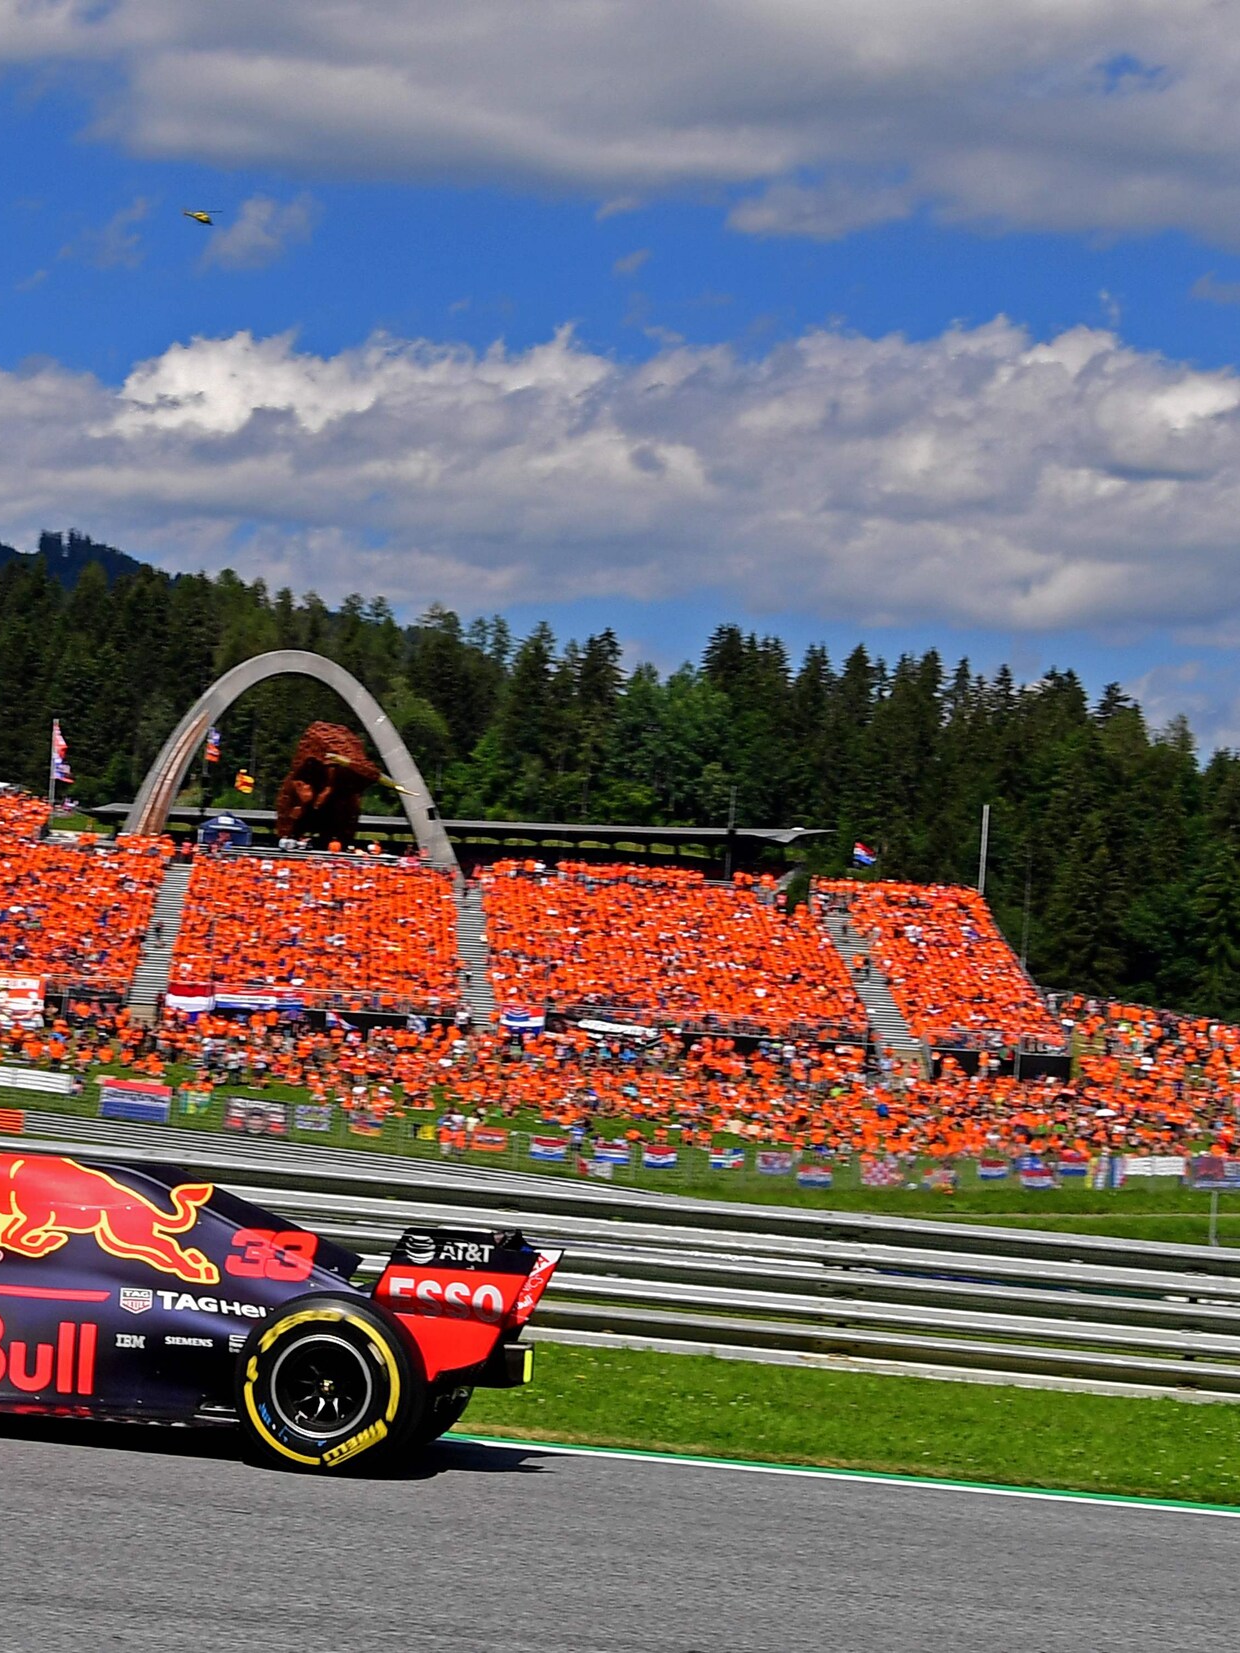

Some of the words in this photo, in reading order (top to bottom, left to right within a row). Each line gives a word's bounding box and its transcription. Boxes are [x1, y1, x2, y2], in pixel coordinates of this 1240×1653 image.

[224, 1228, 318, 1282] 33
[439, 1241, 495, 1263] AT&T
[124, 1290, 149, 1298] TAG
[389, 1276, 503, 1323] ESSO
[115, 1334, 146, 1349] IBM
[164, 1336, 213, 1348] SIEMENS
